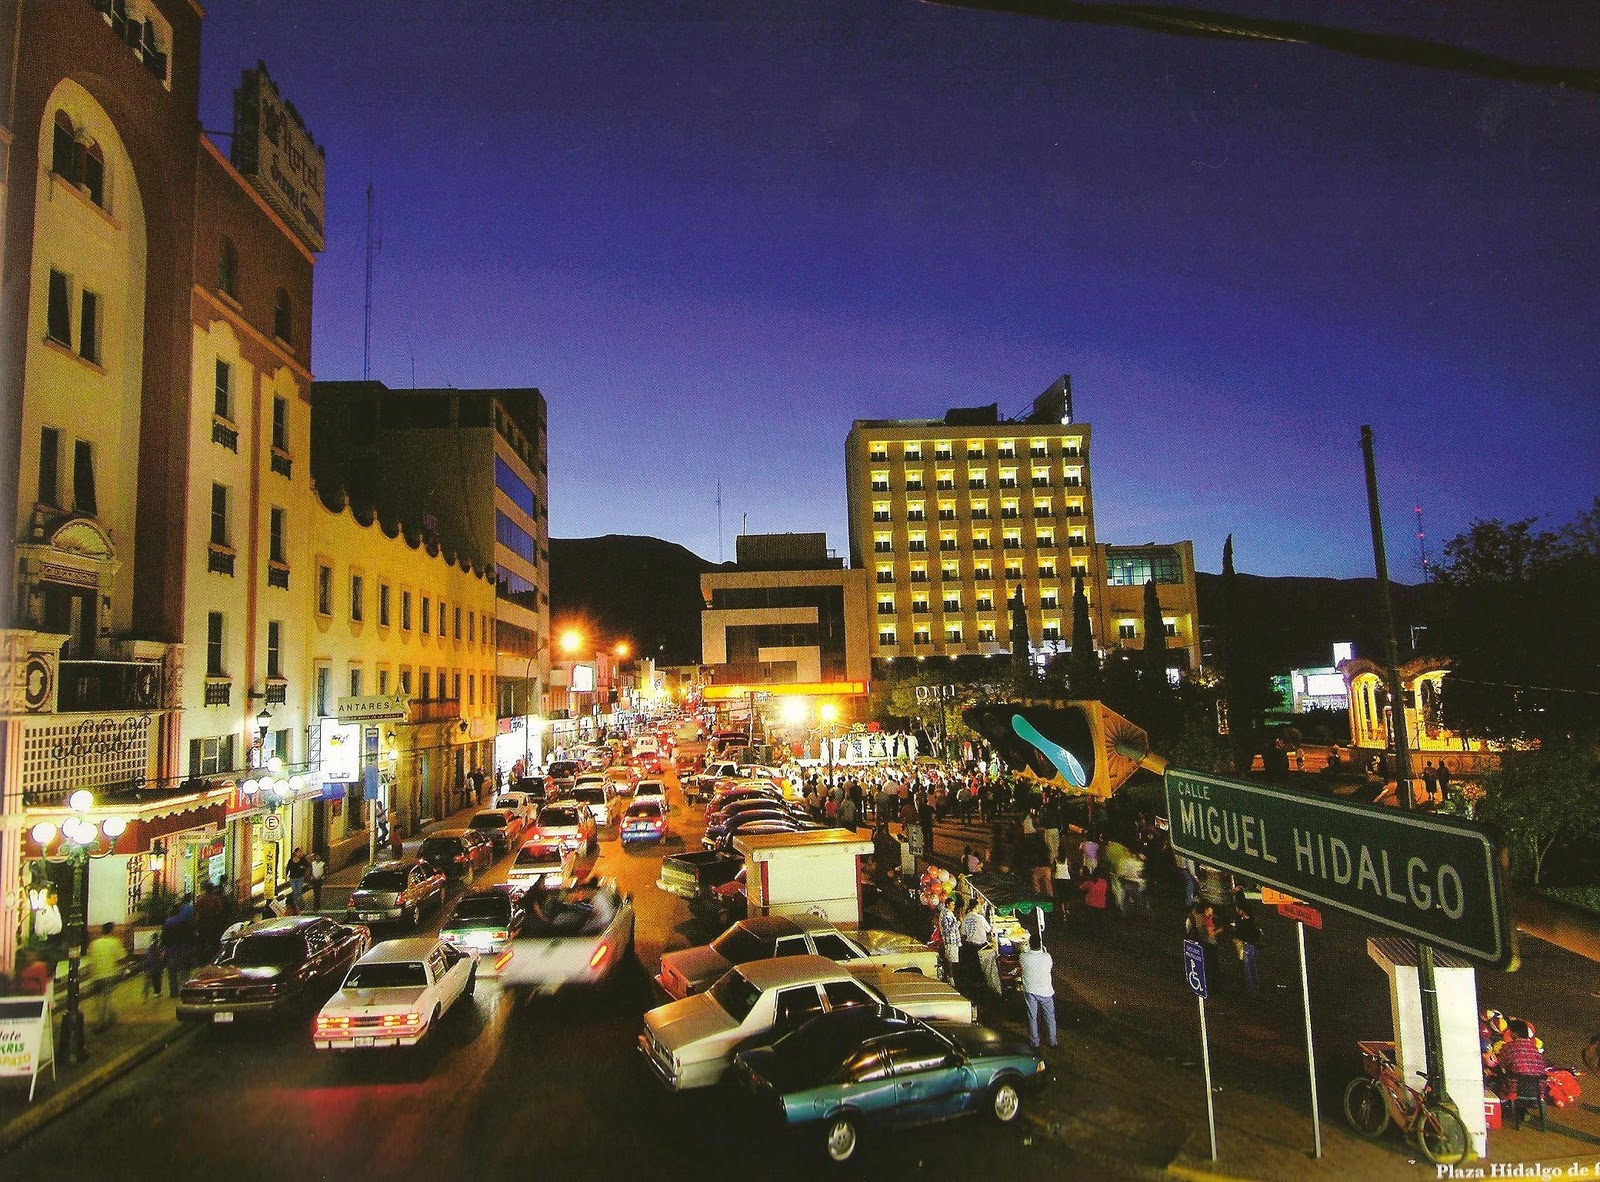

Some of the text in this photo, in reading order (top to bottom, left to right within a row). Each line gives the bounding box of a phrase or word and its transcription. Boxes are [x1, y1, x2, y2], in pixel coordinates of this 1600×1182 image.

[339, 701, 390, 712] ANTARES
[1178, 781, 1210, 801] CALLE
[268, 818, 275, 828] E
[1180, 799, 1464, 920] MIGUEL HIDALGO
